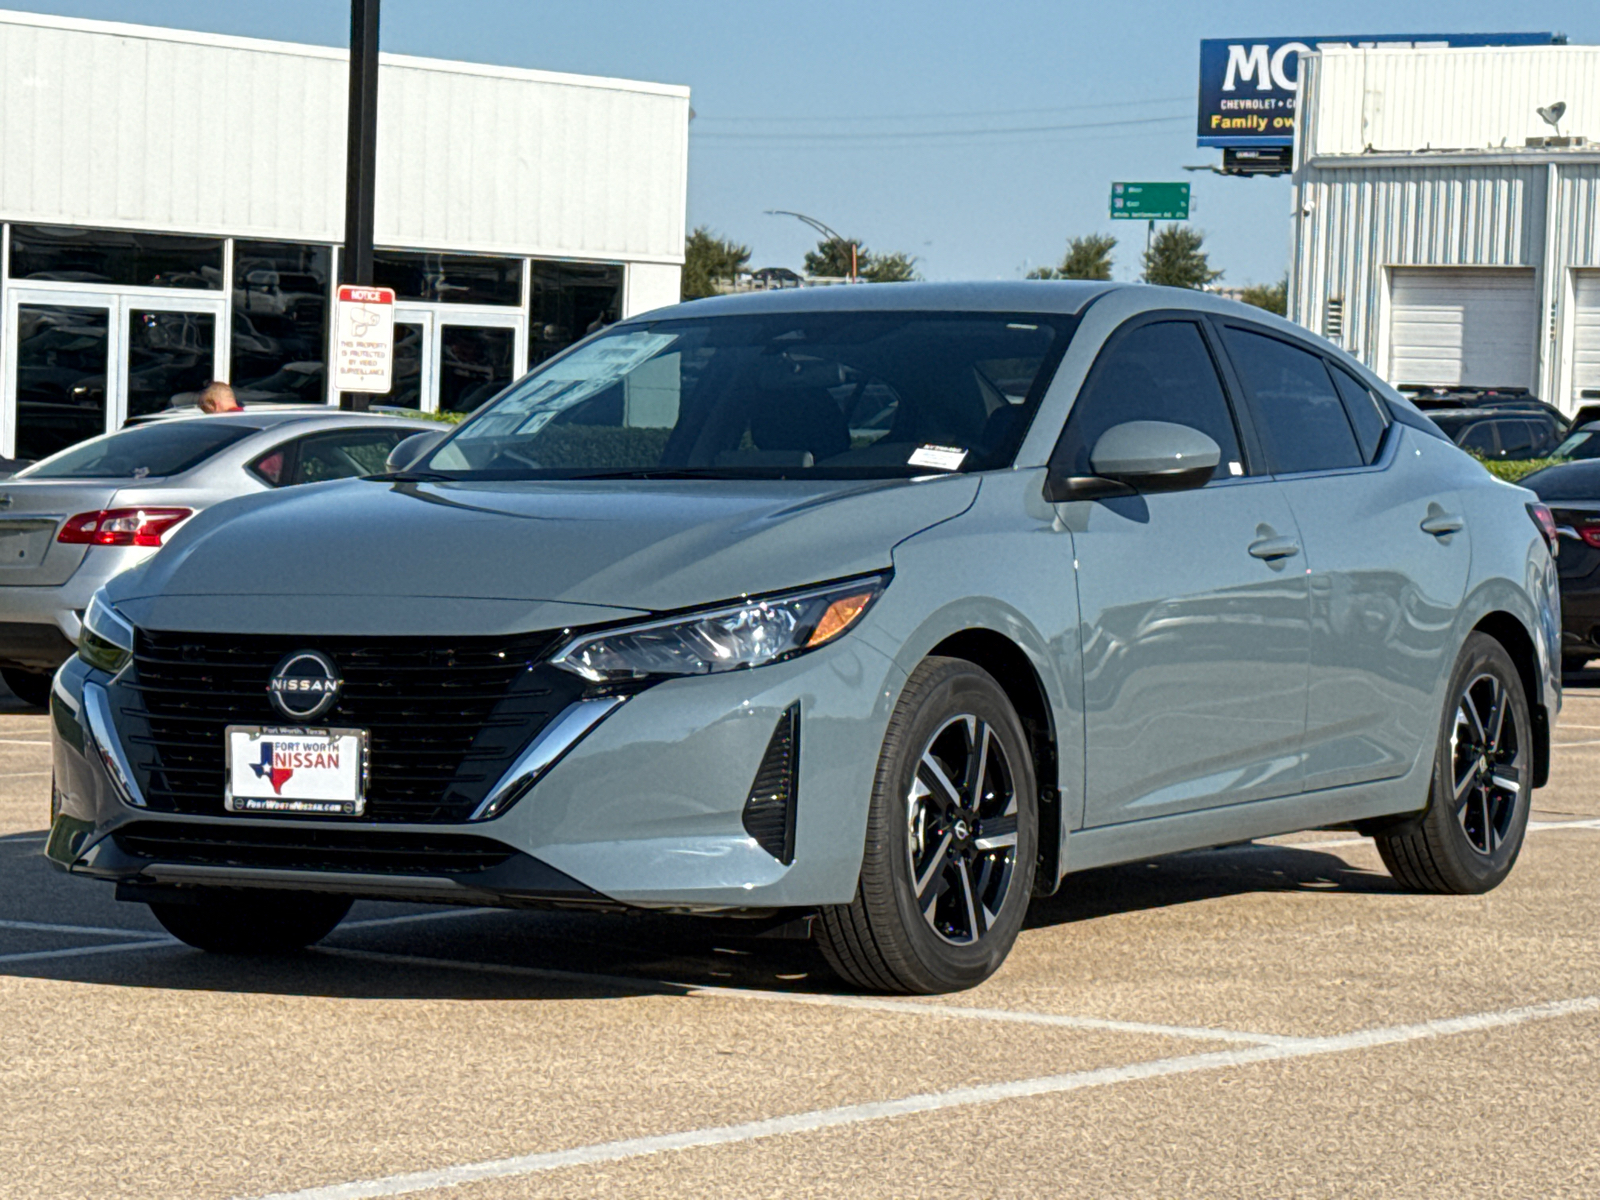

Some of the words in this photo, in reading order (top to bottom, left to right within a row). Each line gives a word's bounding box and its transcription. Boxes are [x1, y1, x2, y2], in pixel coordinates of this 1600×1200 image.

[1220, 98, 1276, 110] CHEVROLET
[1211, 114, 1268, 132] Family
[1273, 117, 1294, 128] ow
[351, 289, 381, 302] NOTICE
[272, 678, 337, 691] NISSAN
[275, 741, 301, 752] FORT
[303, 742, 340, 753] WORTH
[275, 752, 340, 769] NISSAN
